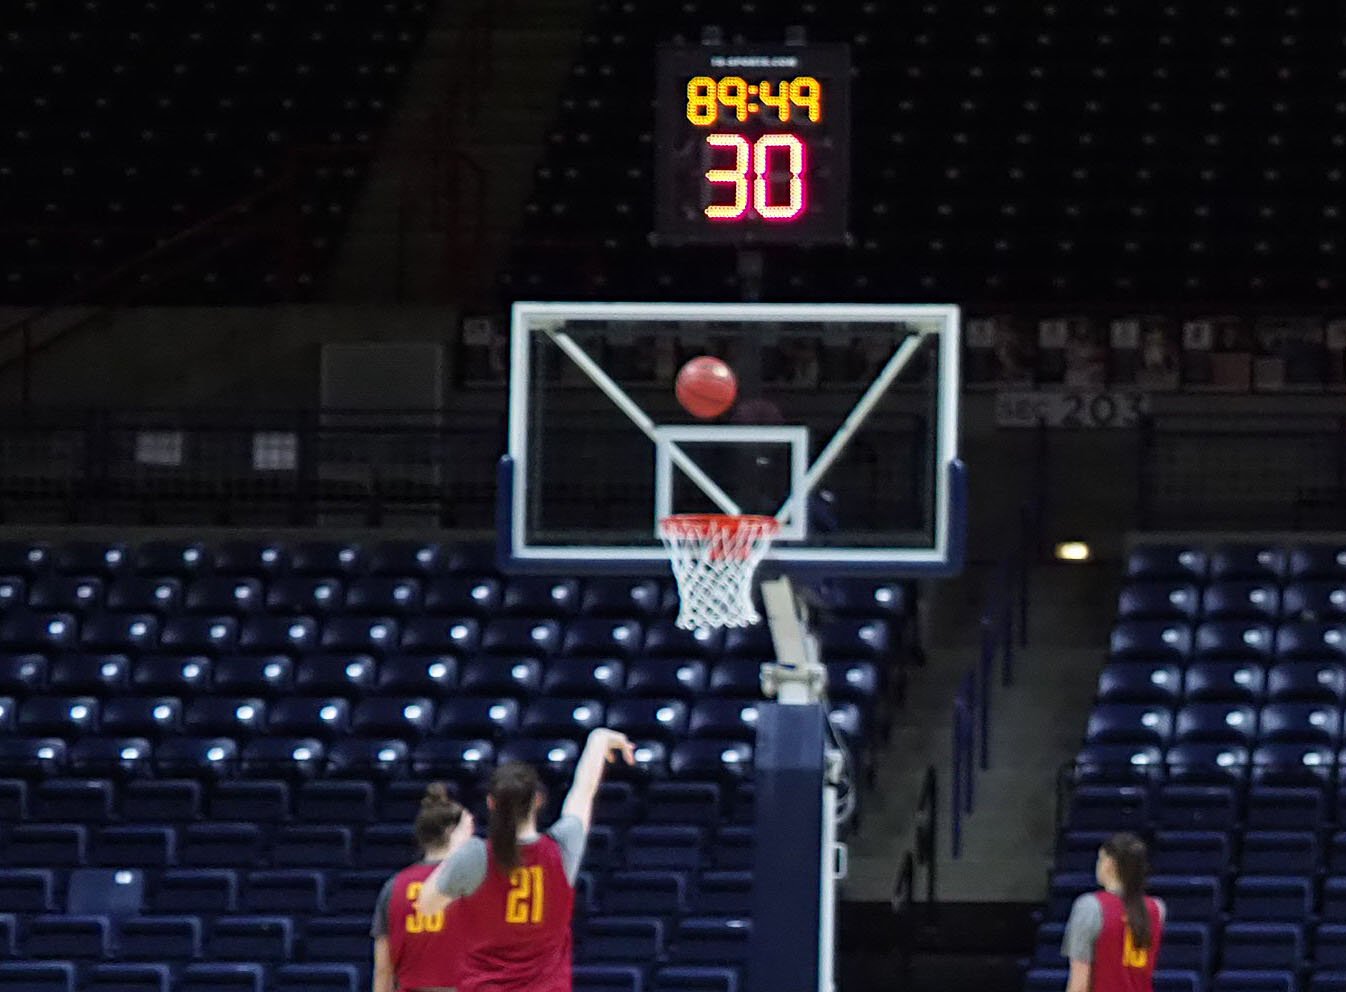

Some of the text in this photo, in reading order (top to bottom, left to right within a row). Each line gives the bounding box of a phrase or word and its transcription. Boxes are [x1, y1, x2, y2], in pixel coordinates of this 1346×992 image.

[686, 76, 821, 125] 89:49
[704, 133, 804, 218] 30
[505, 865, 544, 925] 21
